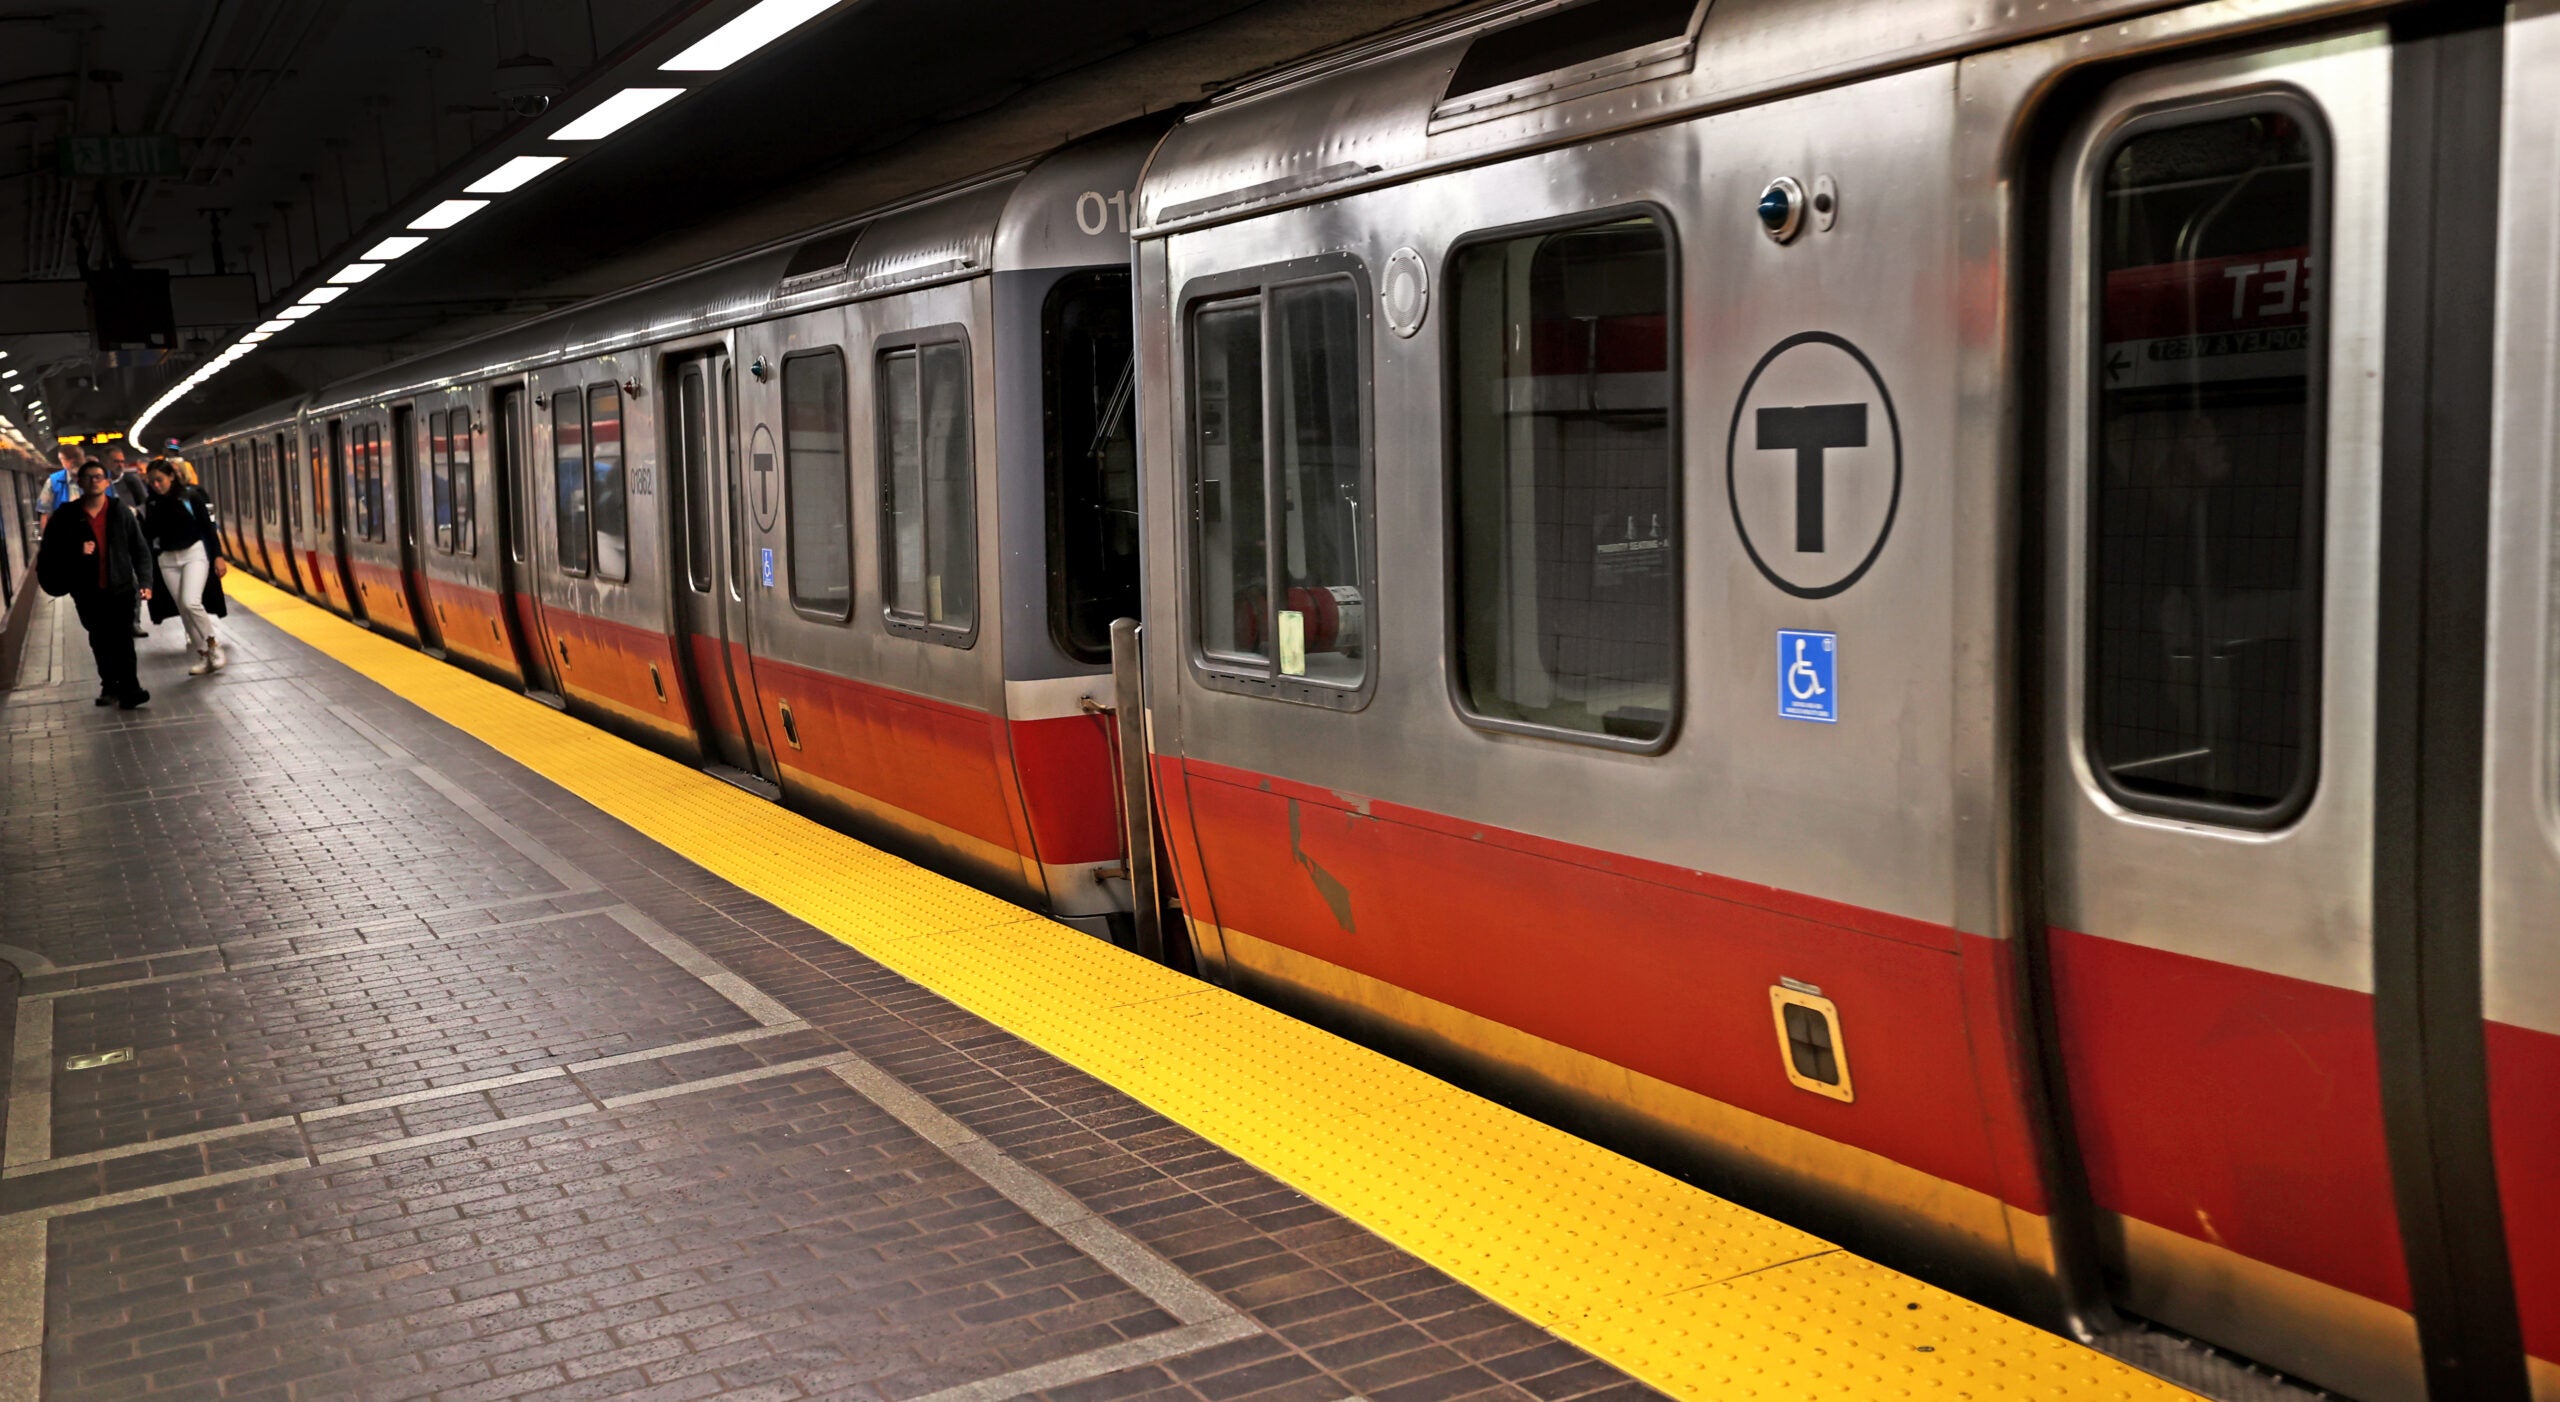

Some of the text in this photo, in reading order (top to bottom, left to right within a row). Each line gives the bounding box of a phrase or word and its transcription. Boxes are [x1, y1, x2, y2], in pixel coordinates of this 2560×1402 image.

[108, 136, 164, 173] EXIT
[1076, 190, 1136, 236] 01
[754, 453, 773, 515] T
[1756, 403, 1867, 553] T
